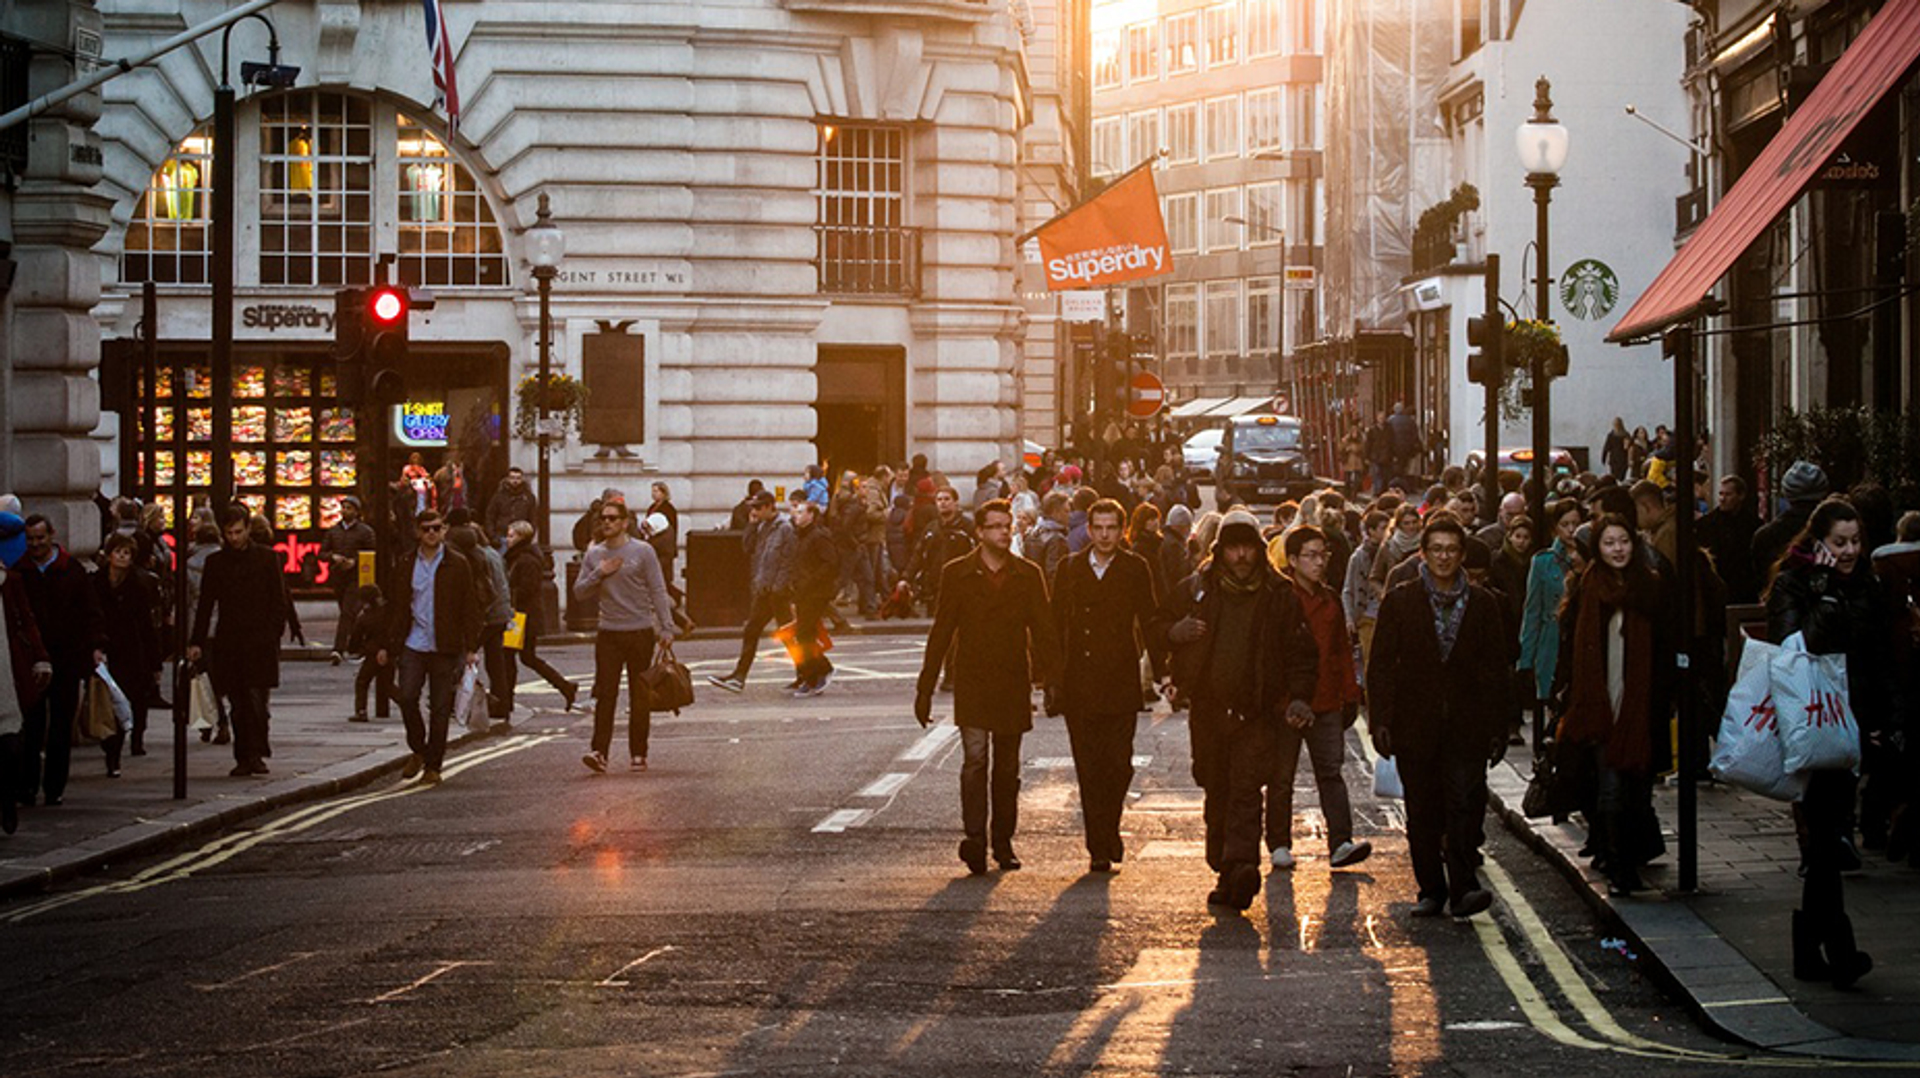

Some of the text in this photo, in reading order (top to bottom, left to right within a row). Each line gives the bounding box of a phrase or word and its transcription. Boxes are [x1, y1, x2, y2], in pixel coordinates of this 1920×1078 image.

[1049, 244, 1164, 282] Superdry
[554, 271, 597, 284] GENT
[607, 271, 657, 284] STREET
[243, 306, 337, 333] Superdry
